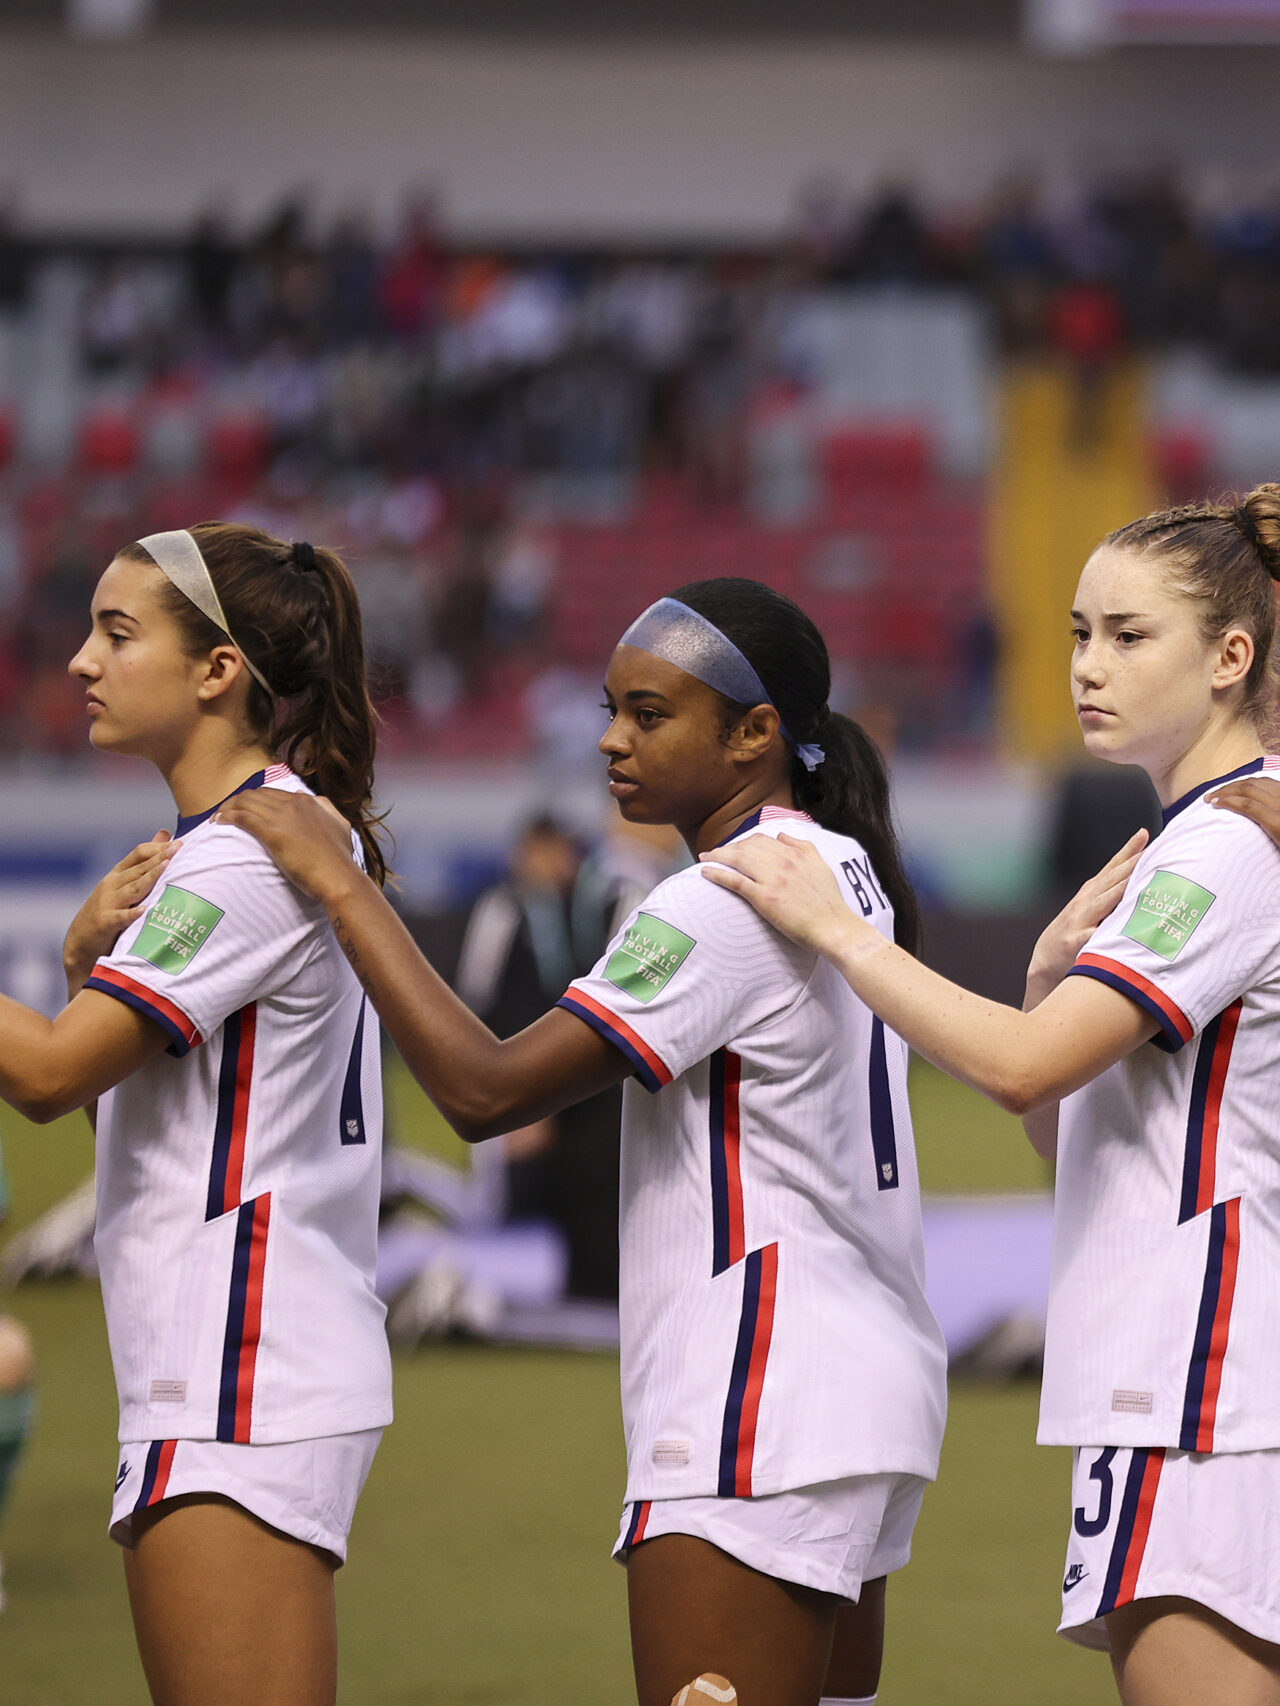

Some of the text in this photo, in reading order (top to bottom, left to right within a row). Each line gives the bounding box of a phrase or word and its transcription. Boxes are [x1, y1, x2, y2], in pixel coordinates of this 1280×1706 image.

[840, 854, 890, 917] BY
[1142, 896, 1193, 926] FOOTBALL
[1145, 887, 1199, 918] LIVING
[151, 911, 199, 941] FOOTBALL
[155, 903, 206, 934] LIVING
[1157, 919, 1182, 942] FIFA
[164, 936, 188, 958] FIFA
[629, 930, 678, 963] LIVING
[636, 964, 661, 987] FIFA
